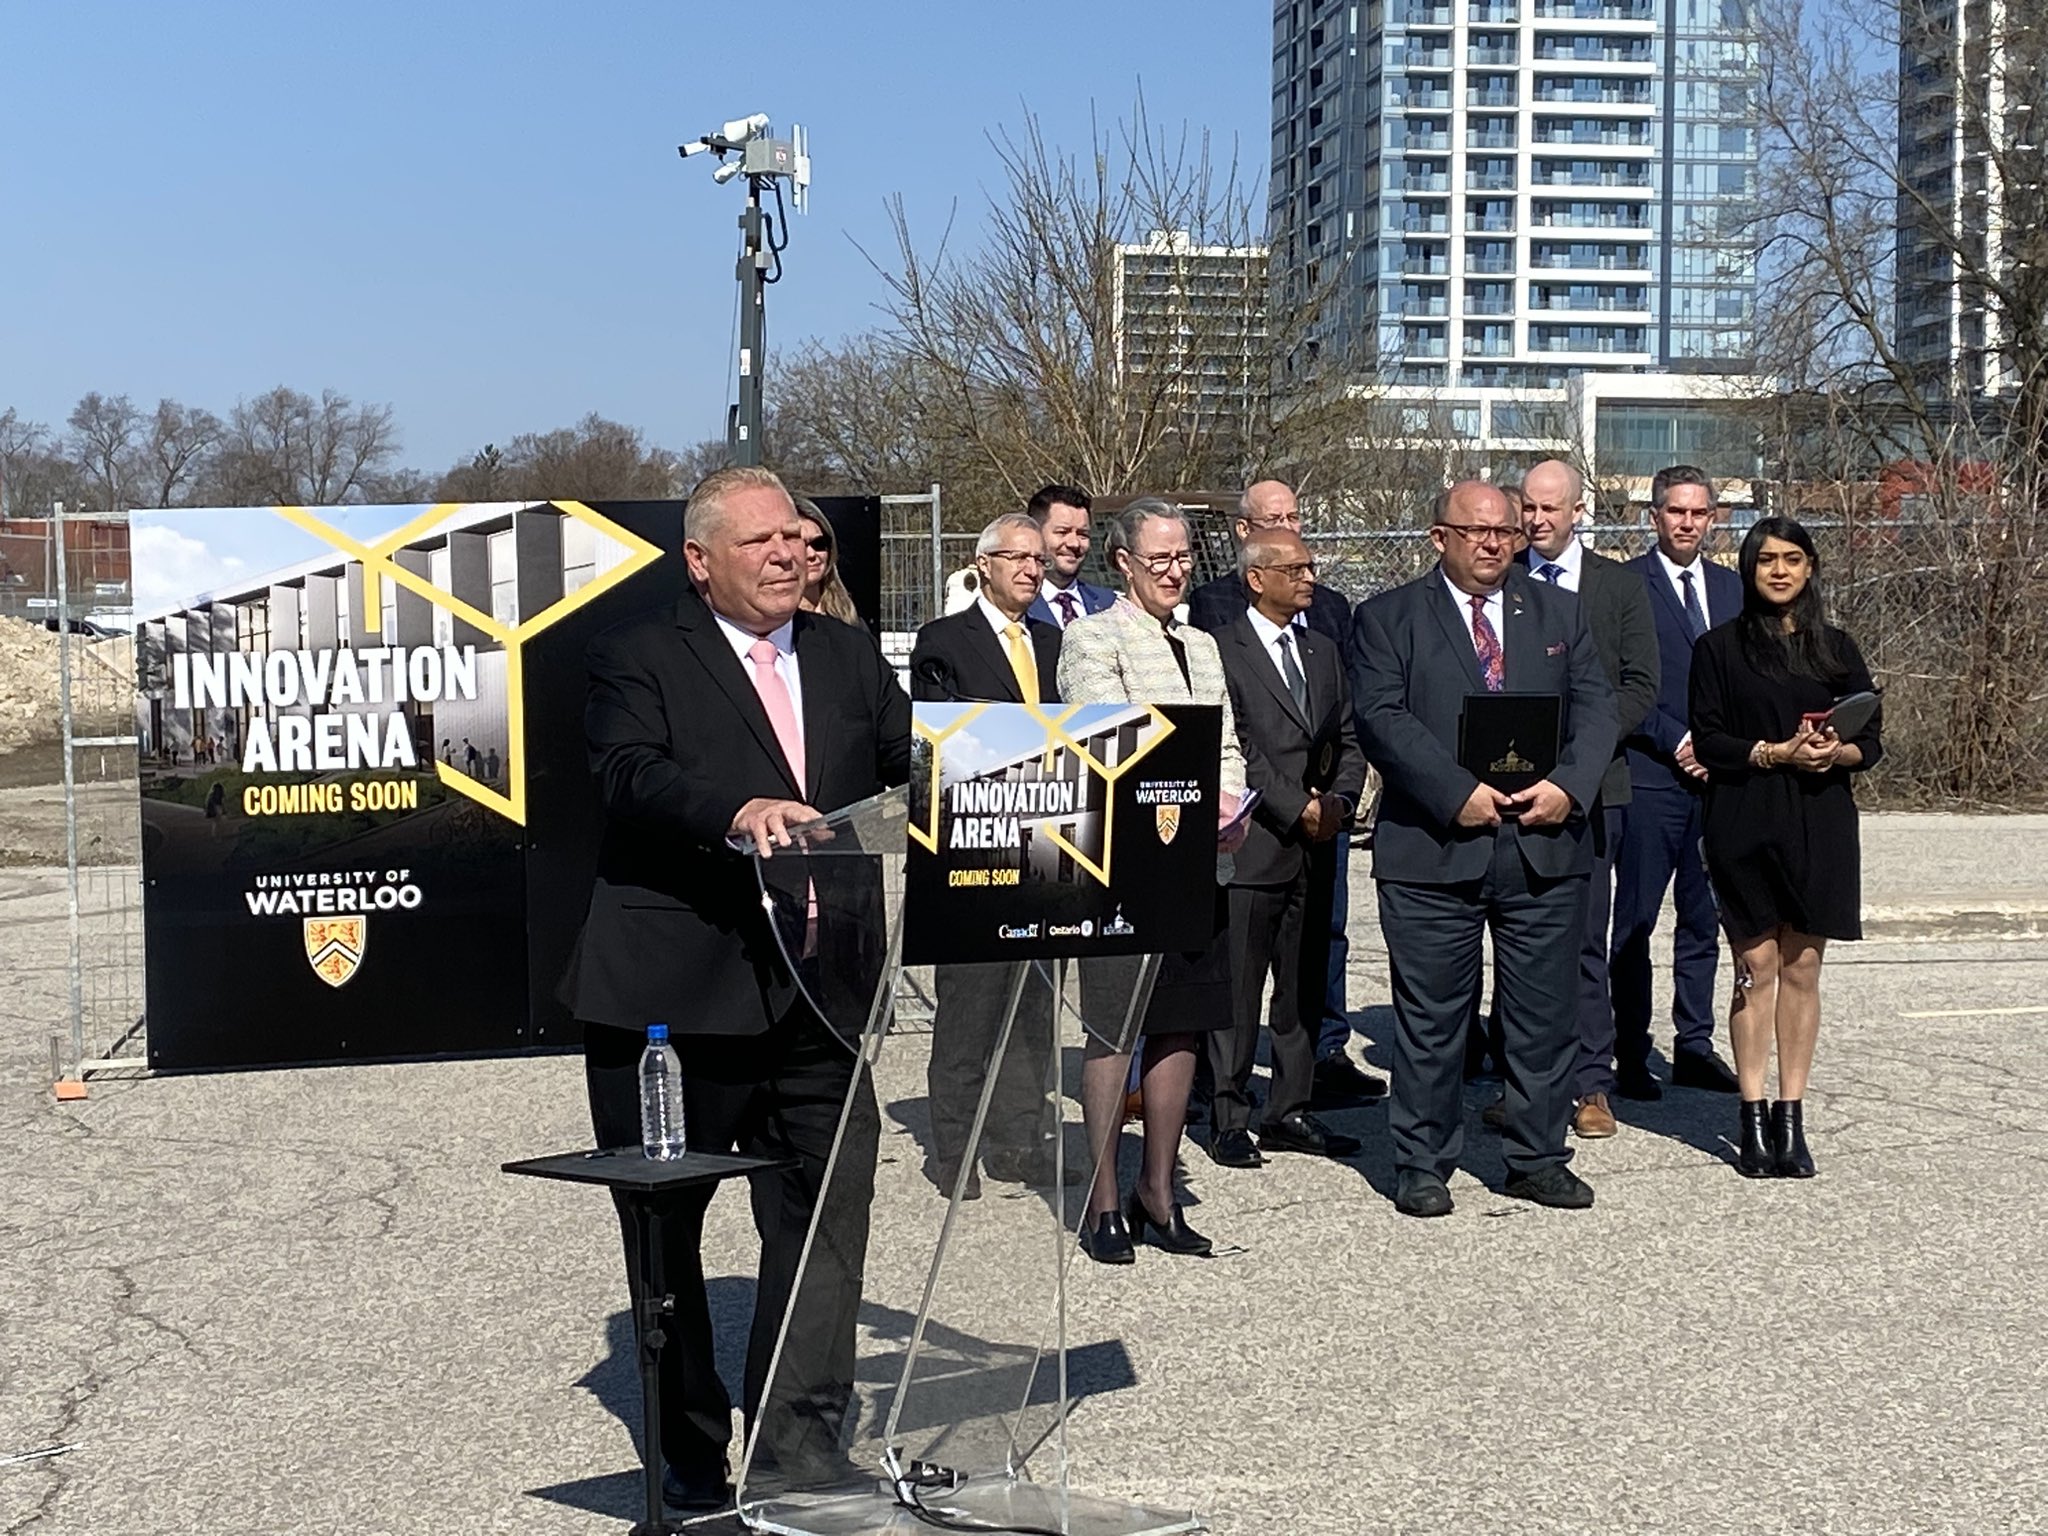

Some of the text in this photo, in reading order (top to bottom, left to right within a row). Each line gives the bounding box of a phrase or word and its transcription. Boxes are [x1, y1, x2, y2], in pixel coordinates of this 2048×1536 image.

[173, 645, 477, 709] INNOVATION
[242, 712, 416, 772] ARENA
[243, 780, 417, 815] COMING SOON
[952, 781, 1074, 813] INNOVATION
[1136, 789, 1201, 804] WATERLOO
[949, 817, 1020, 849] ARENA
[256, 869, 410, 888] UNIVERSITY OF
[949, 869, 1020, 887] COMING SOON
[245, 885, 422, 915] WATERLOO
